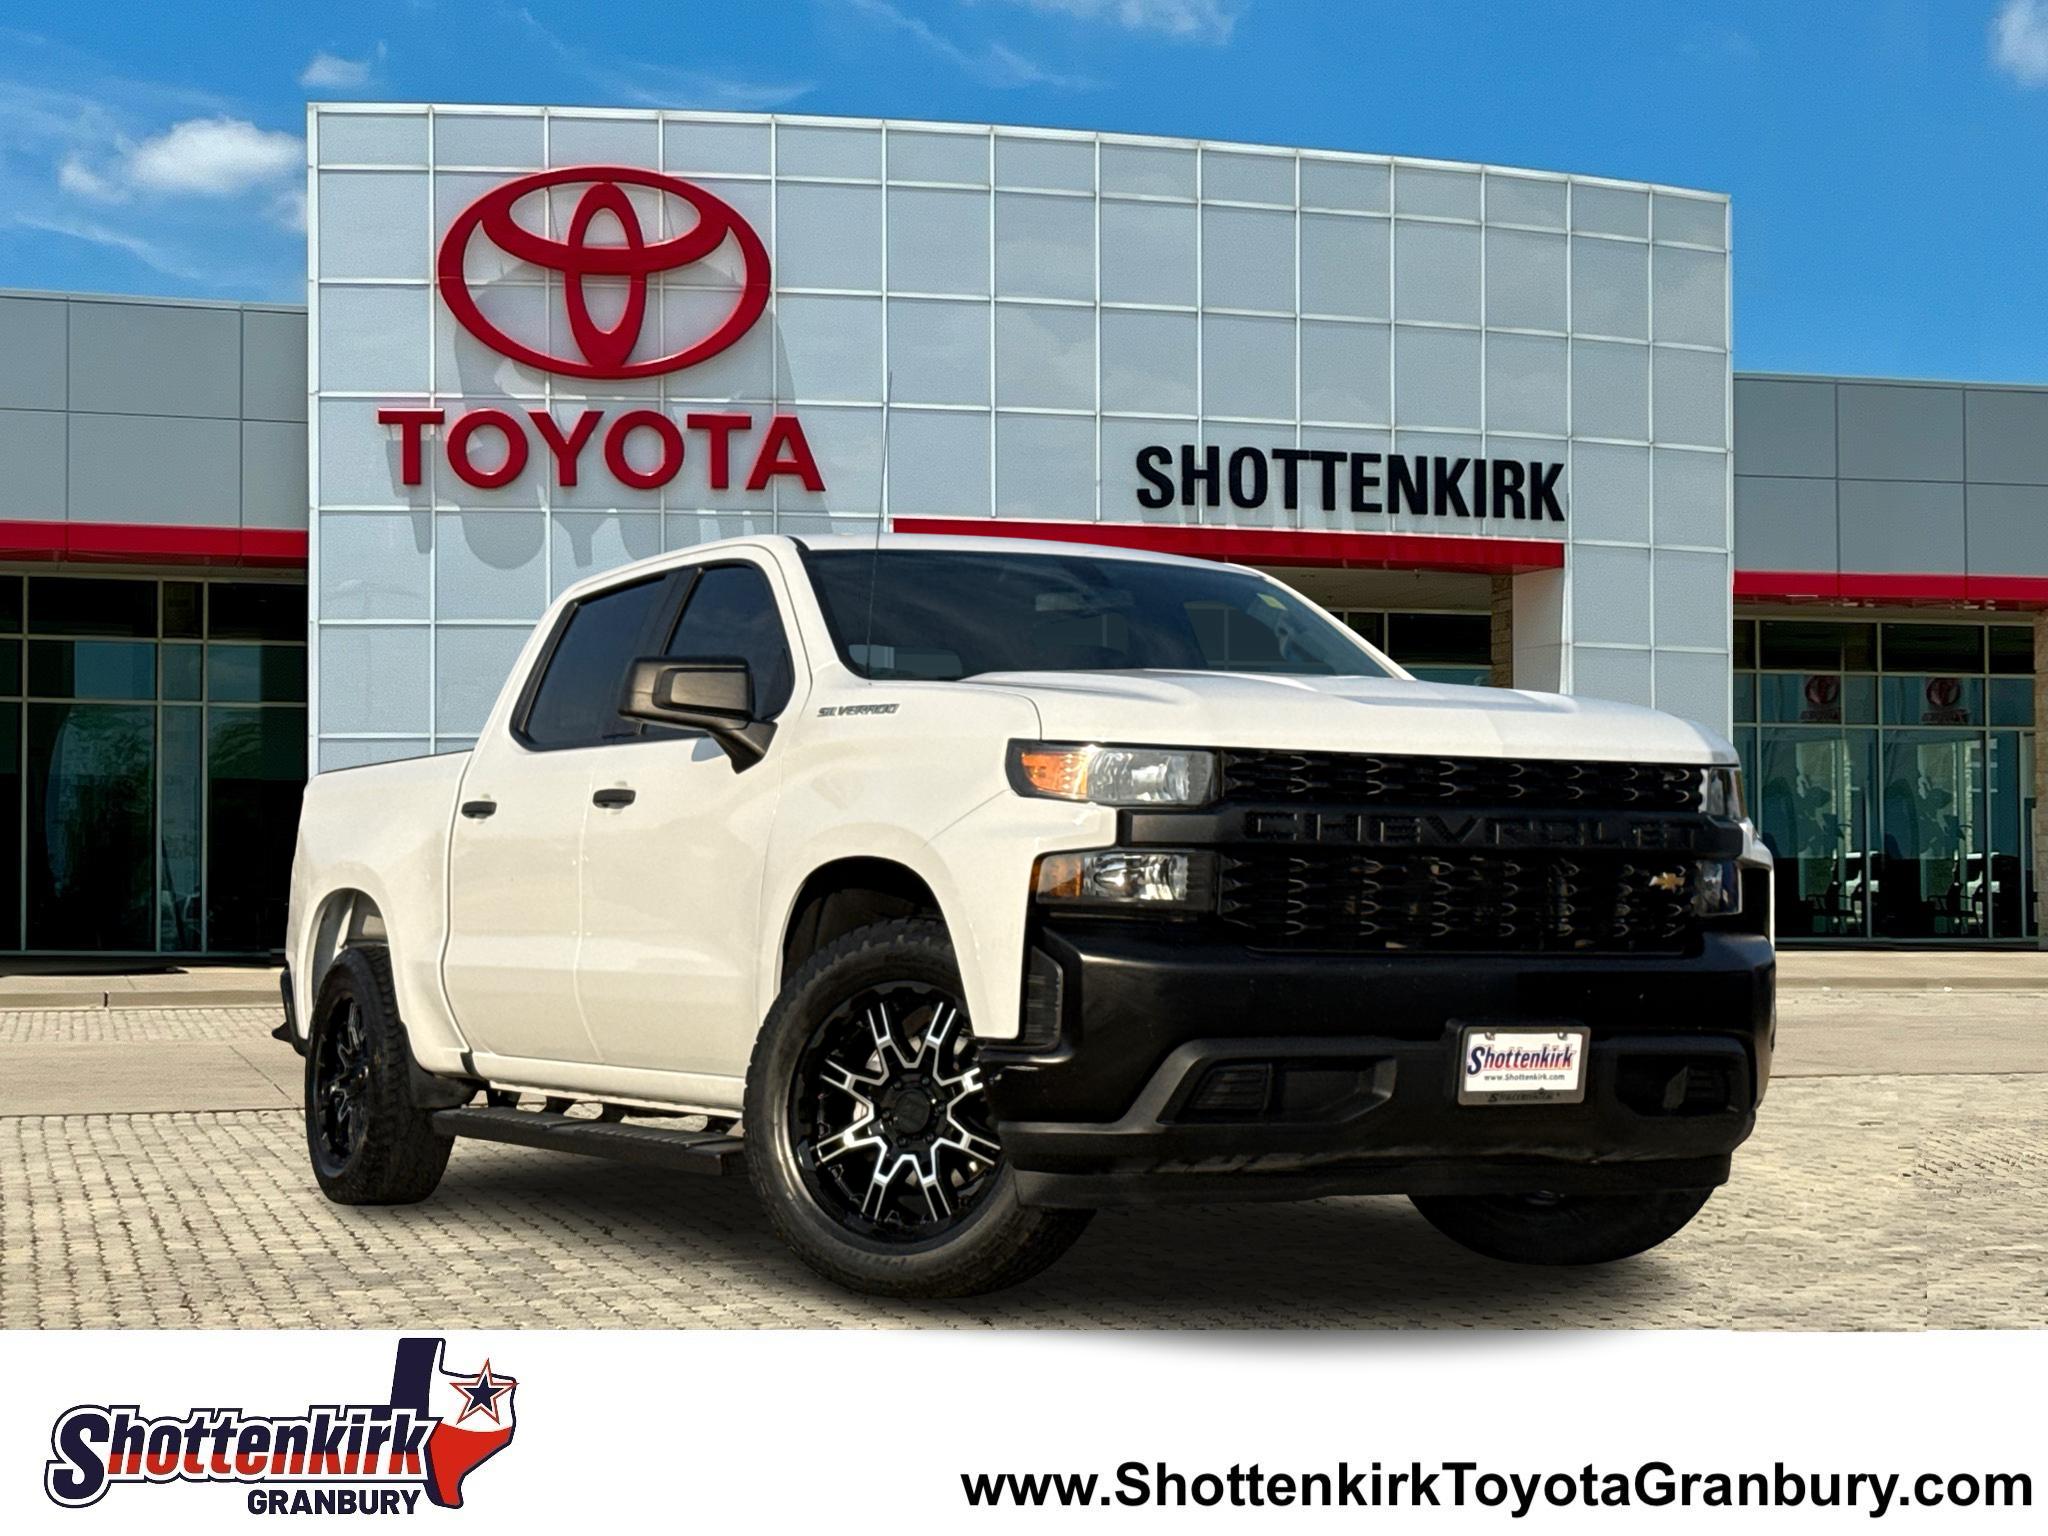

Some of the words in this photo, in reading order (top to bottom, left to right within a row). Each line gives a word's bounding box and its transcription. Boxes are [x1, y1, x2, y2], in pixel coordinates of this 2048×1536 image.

[377, 406, 826, 492] TOYOTA
[1136, 445, 1565, 522] SHOTTENKIRK
[817, 703, 899, 717] SILVERADO
[1245, 811, 1699, 848] CHEVROLET
[1467, 1044, 1573, 1075] Shottenkirk
[1484, 1073, 1565, 1081] www.Shottenkirk.com
